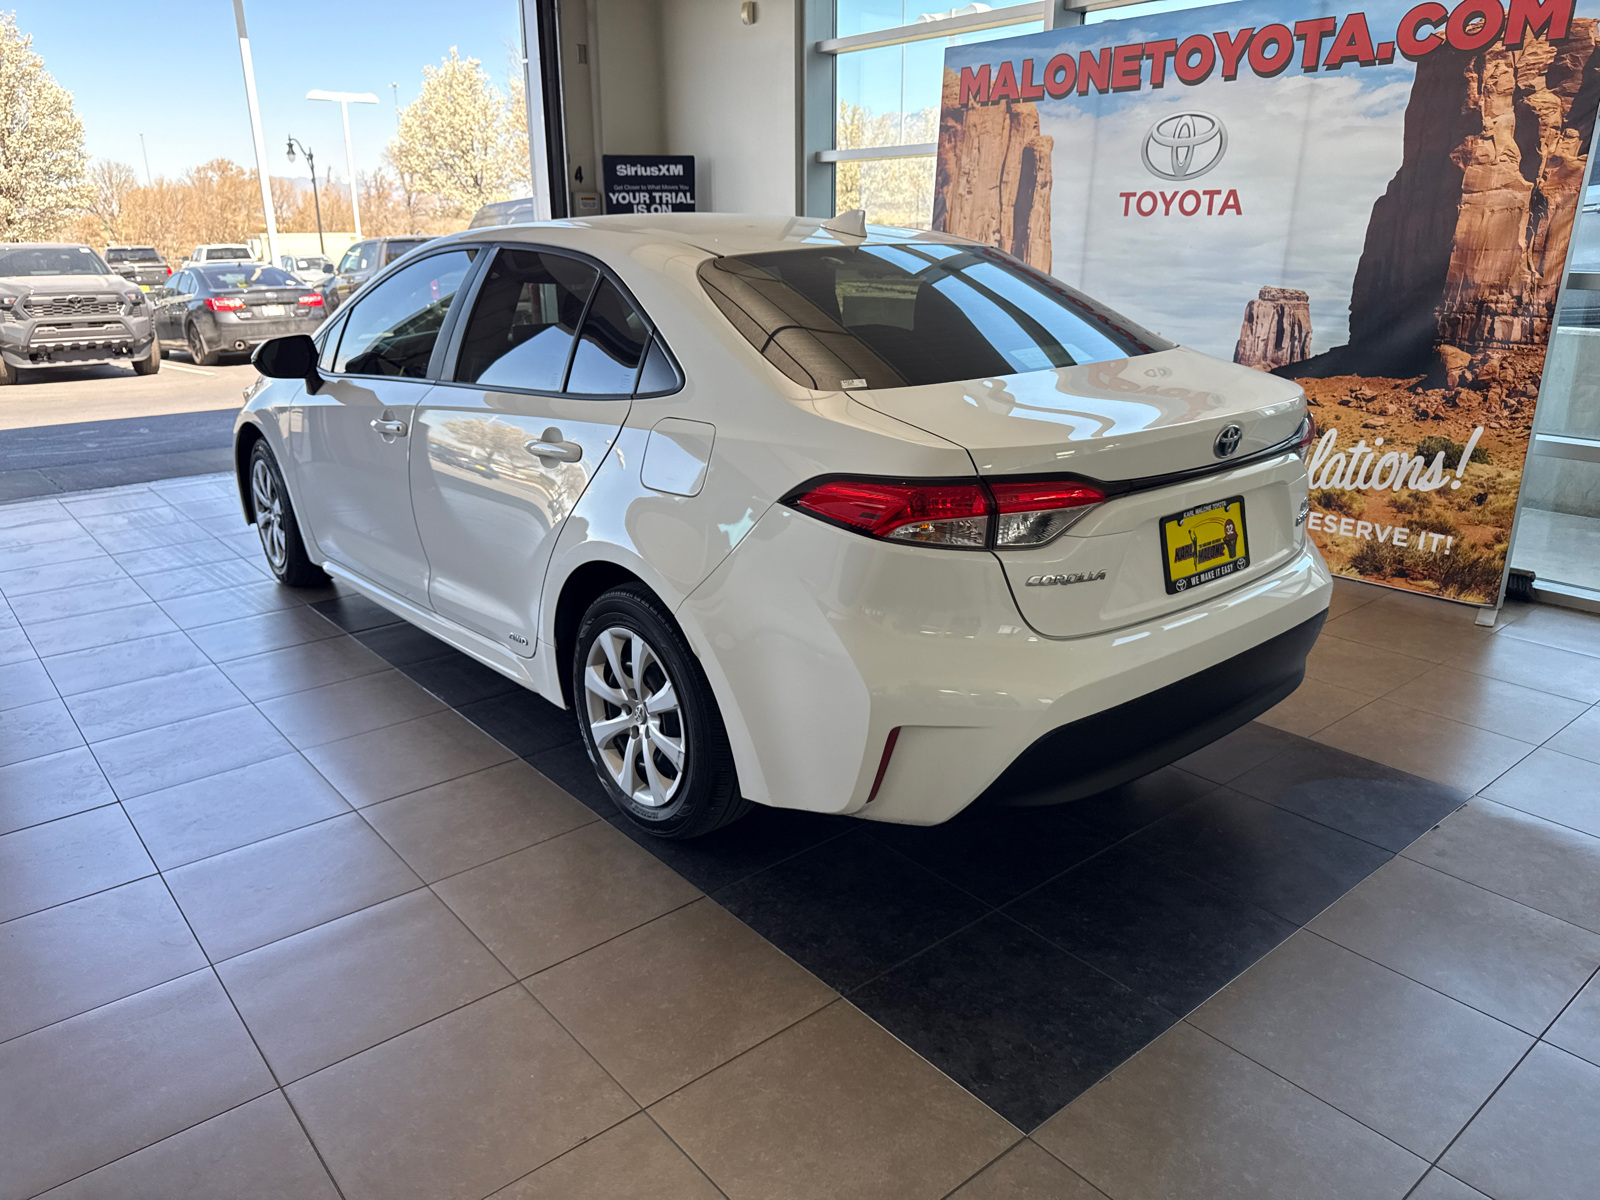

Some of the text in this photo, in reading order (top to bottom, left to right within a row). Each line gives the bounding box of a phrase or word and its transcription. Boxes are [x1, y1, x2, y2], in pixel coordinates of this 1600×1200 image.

[958, 0, 1576, 107] MALONETOYOTA.COM
[574, 165, 584, 184] 4
[616, 164, 684, 177] SiriusXM
[608, 192, 650, 205] YOUR
[652, 192, 695, 204] TRIAL
[1119, 189, 1243, 217] TOYOTA
[633, 204, 673, 214] IS ON
[1308, 426, 1484, 492] lations!
[1225, 523, 1234, 535] 32
[1308, 511, 1410, 547] ESERVE
[1418, 531, 1454, 555] IT!
[1025, 569, 1107, 586] COROLLA
[1191, 563, 1233, 586] WE MAKE IT EASY
